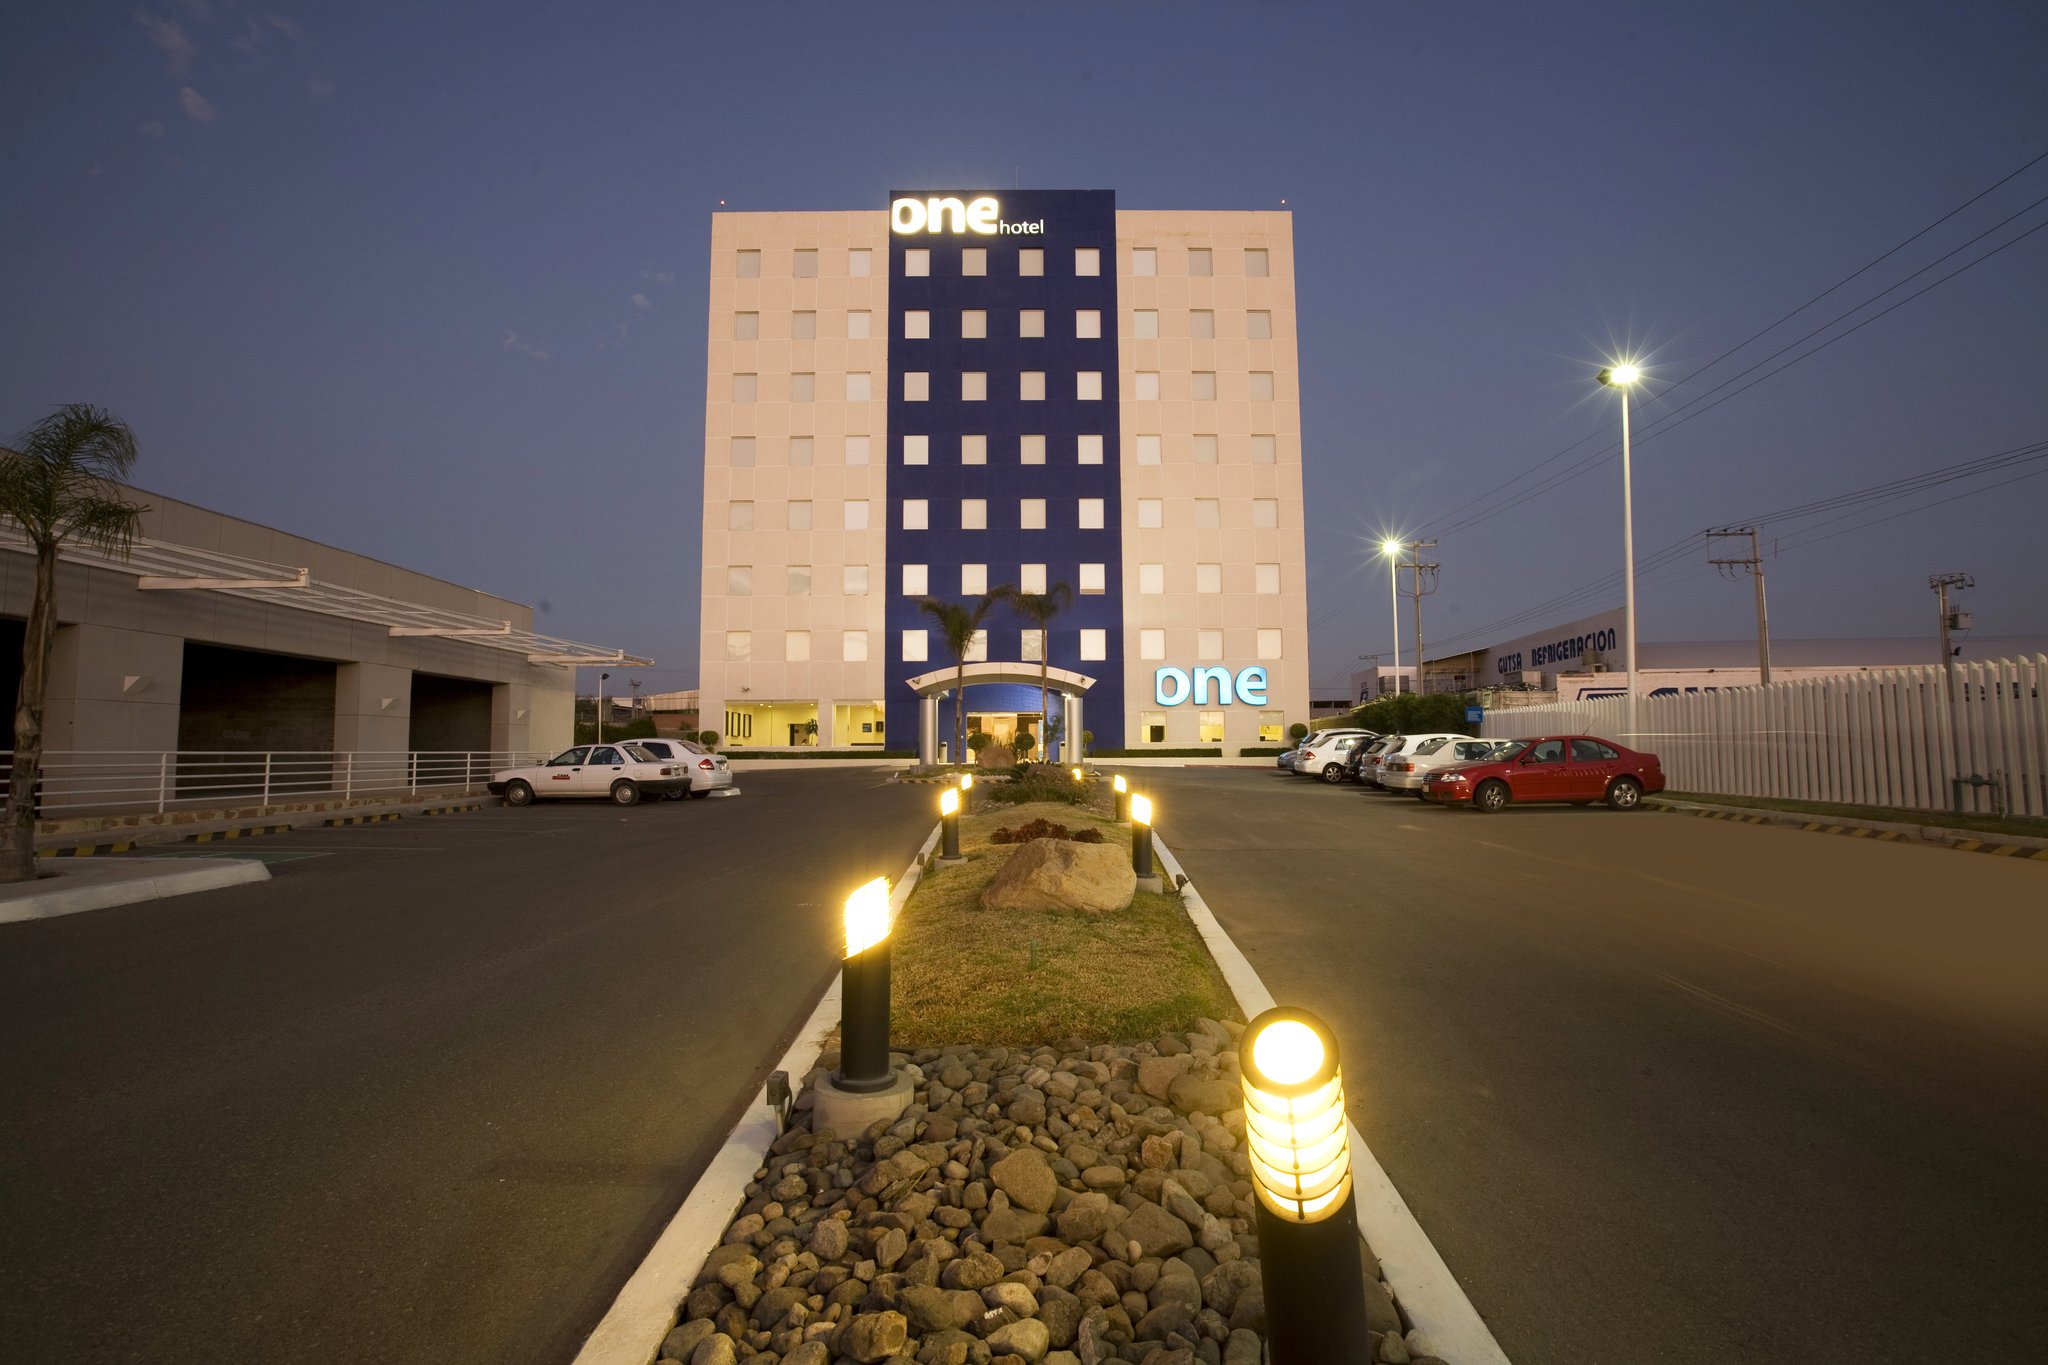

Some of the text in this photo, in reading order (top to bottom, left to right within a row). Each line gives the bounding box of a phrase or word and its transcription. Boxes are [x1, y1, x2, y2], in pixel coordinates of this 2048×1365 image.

[891, 196, 1044, 235] one hotel
[1498, 652, 1522, 674] GUTSA
[1155, 665, 1268, 706] one
